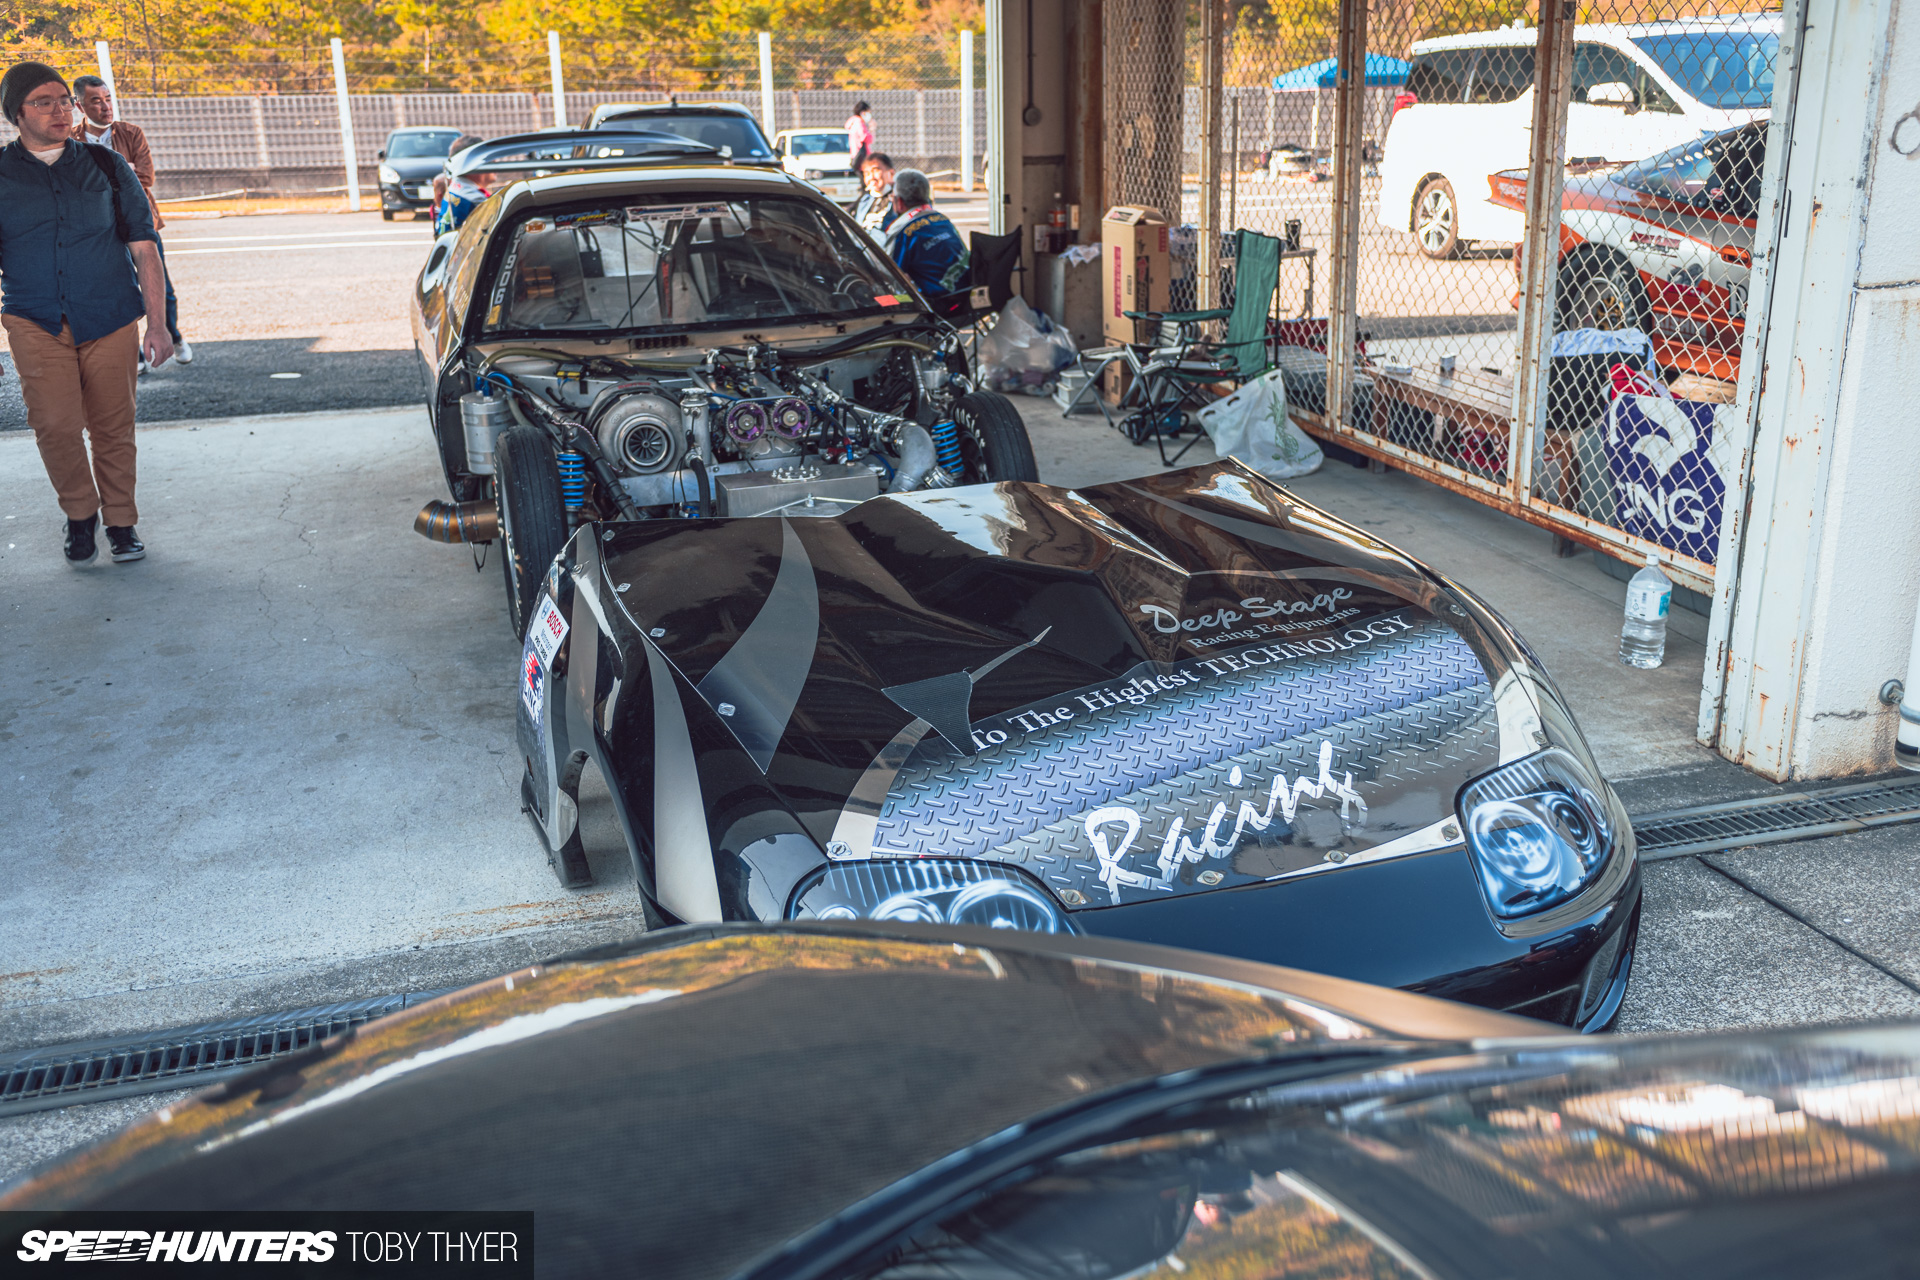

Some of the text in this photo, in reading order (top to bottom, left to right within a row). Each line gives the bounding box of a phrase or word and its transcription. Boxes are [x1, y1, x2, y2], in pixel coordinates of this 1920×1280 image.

[546, 610, 564, 640] BOSCH
[1139, 587, 1352, 634] Deep Stage
[1186, 606, 1361, 649] Racing Equipments
[970, 613, 1414, 752] To The Highest TECHNOLOGY
[1084, 740, 1369, 906] Racing
